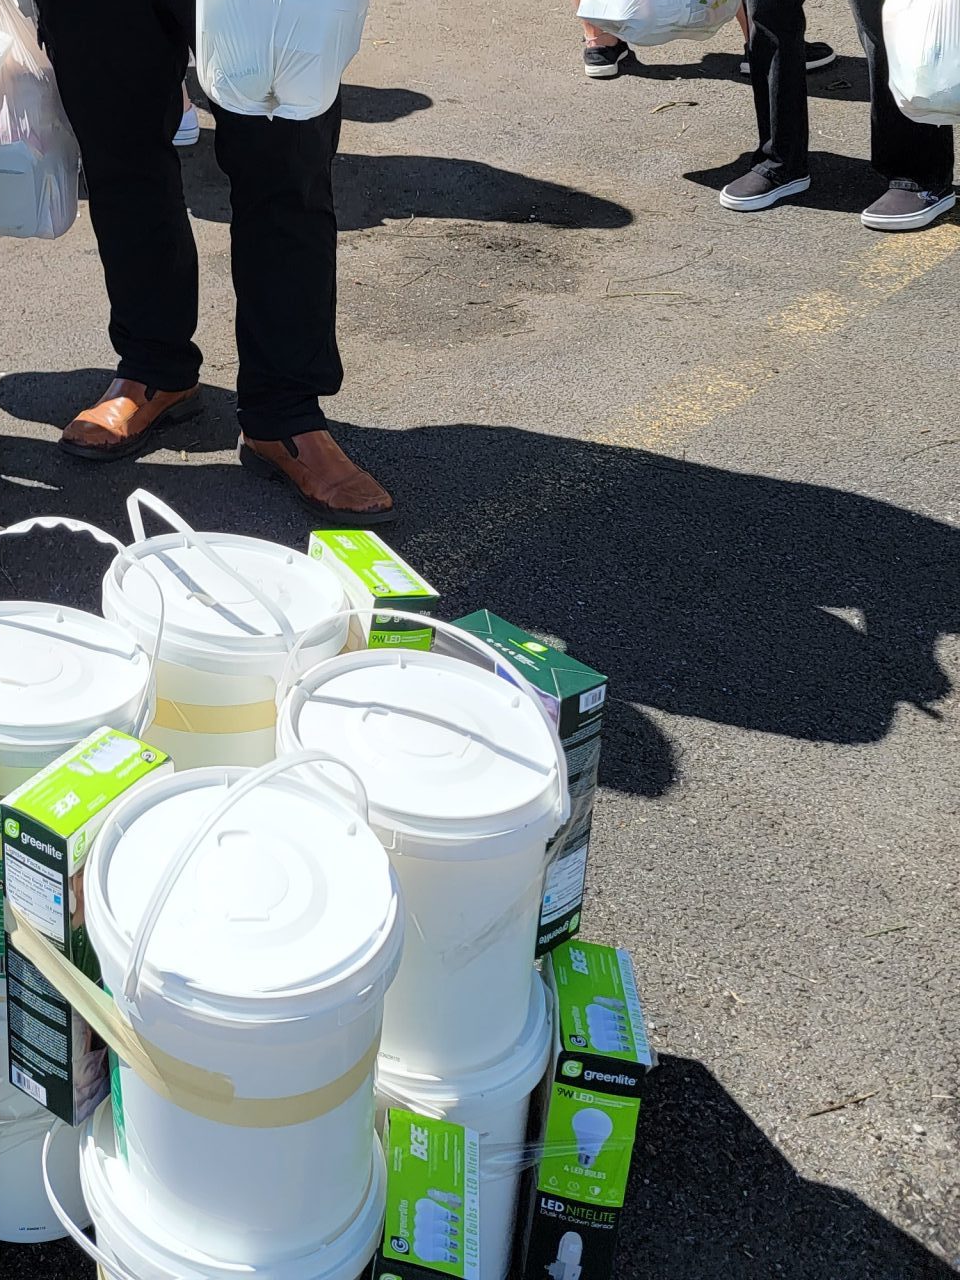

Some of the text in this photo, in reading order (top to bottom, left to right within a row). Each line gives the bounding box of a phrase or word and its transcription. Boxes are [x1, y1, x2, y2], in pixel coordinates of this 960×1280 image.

[21, 832, 63, 860] greenlite
[584, 1070, 637, 1086] greenlite
[410, 1123, 428, 1161] BGE
[467, 1140, 478, 1175] Nitelite
[571, 1167, 584, 1175] LED
[465, 1178, 478, 1195] LED
[466, 1207, 478, 1235] Bulbs
[541, 1197, 616, 1223] LED NITELITE
[568, 1216, 589, 1226] Dawn
[590, 1221, 614, 1229] Sensor
[466, 1239, 478, 1257] LED
